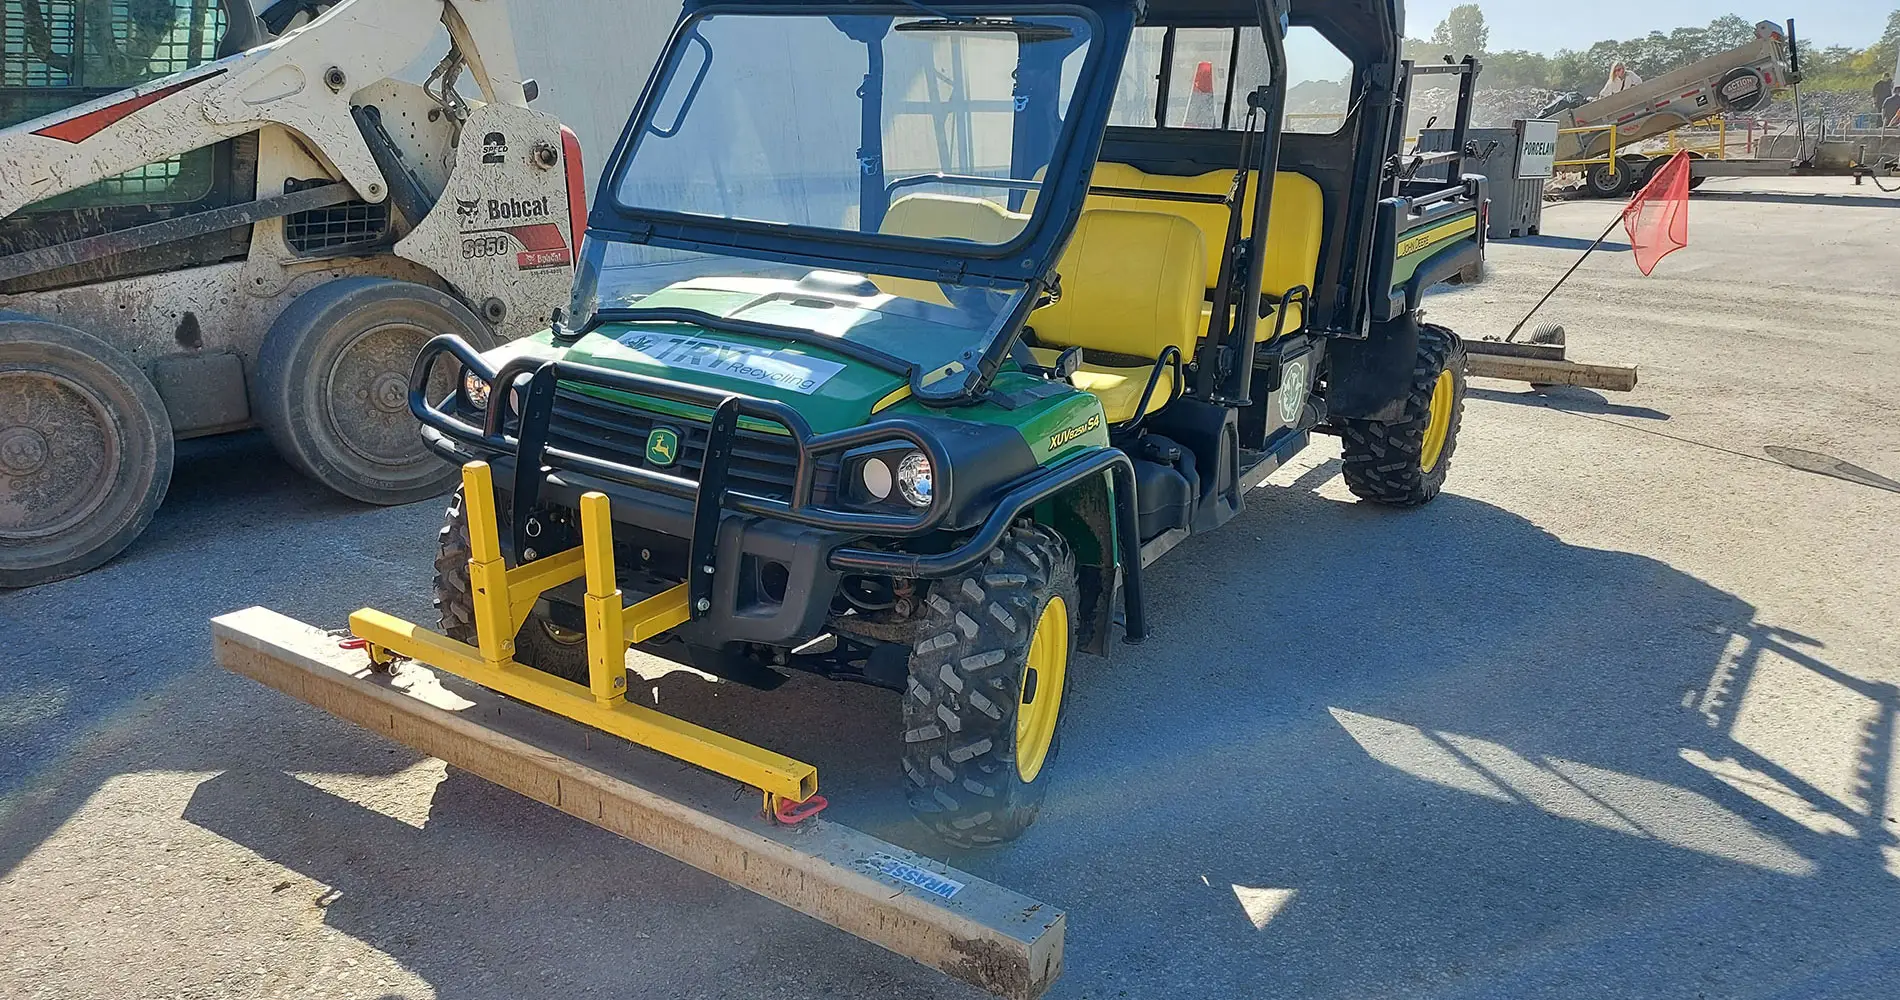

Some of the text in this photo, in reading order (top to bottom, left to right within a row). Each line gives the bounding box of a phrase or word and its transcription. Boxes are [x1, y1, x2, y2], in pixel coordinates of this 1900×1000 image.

[1727, 78, 1752, 91] ACTION
[482, 131, 506, 164] 2
[1524, 142, 1554, 155] PORCELAIN
[488, 196, 549, 220] Bobcat
[462, 235, 508, 259] S650
[537, 252, 562, 264] Bobcat
[656, 337, 815, 389] TRY Recycling
[881, 861, 956, 898] WRASSE
